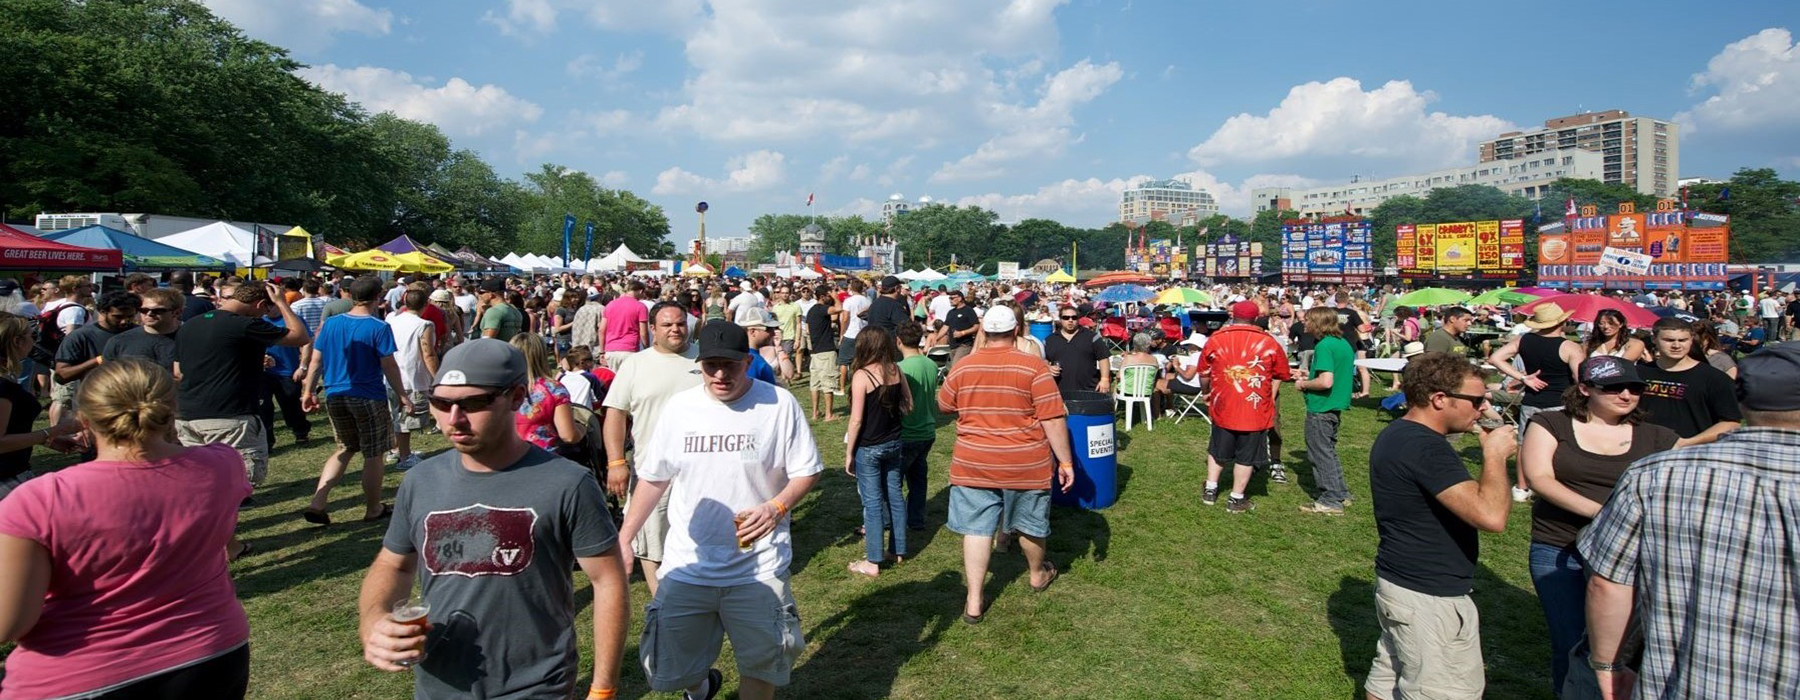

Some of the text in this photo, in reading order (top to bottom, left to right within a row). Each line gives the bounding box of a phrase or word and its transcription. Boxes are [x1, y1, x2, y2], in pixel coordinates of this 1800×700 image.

[1583, 207, 1594, 215] 01
[1620, 204, 1632, 212] 01
[1658, 202, 1672, 211] 01
[4, 249, 28, 259] GREAT
[29, 250, 47, 260] BEER
[48, 250, 66, 260] LIVES
[67, 251, 86, 261] HERE.
[1645, 383, 1685, 395] MUSE
[684, 434, 755, 453] HILFIGER
[1090, 438, 1113, 447] SPECIAL
